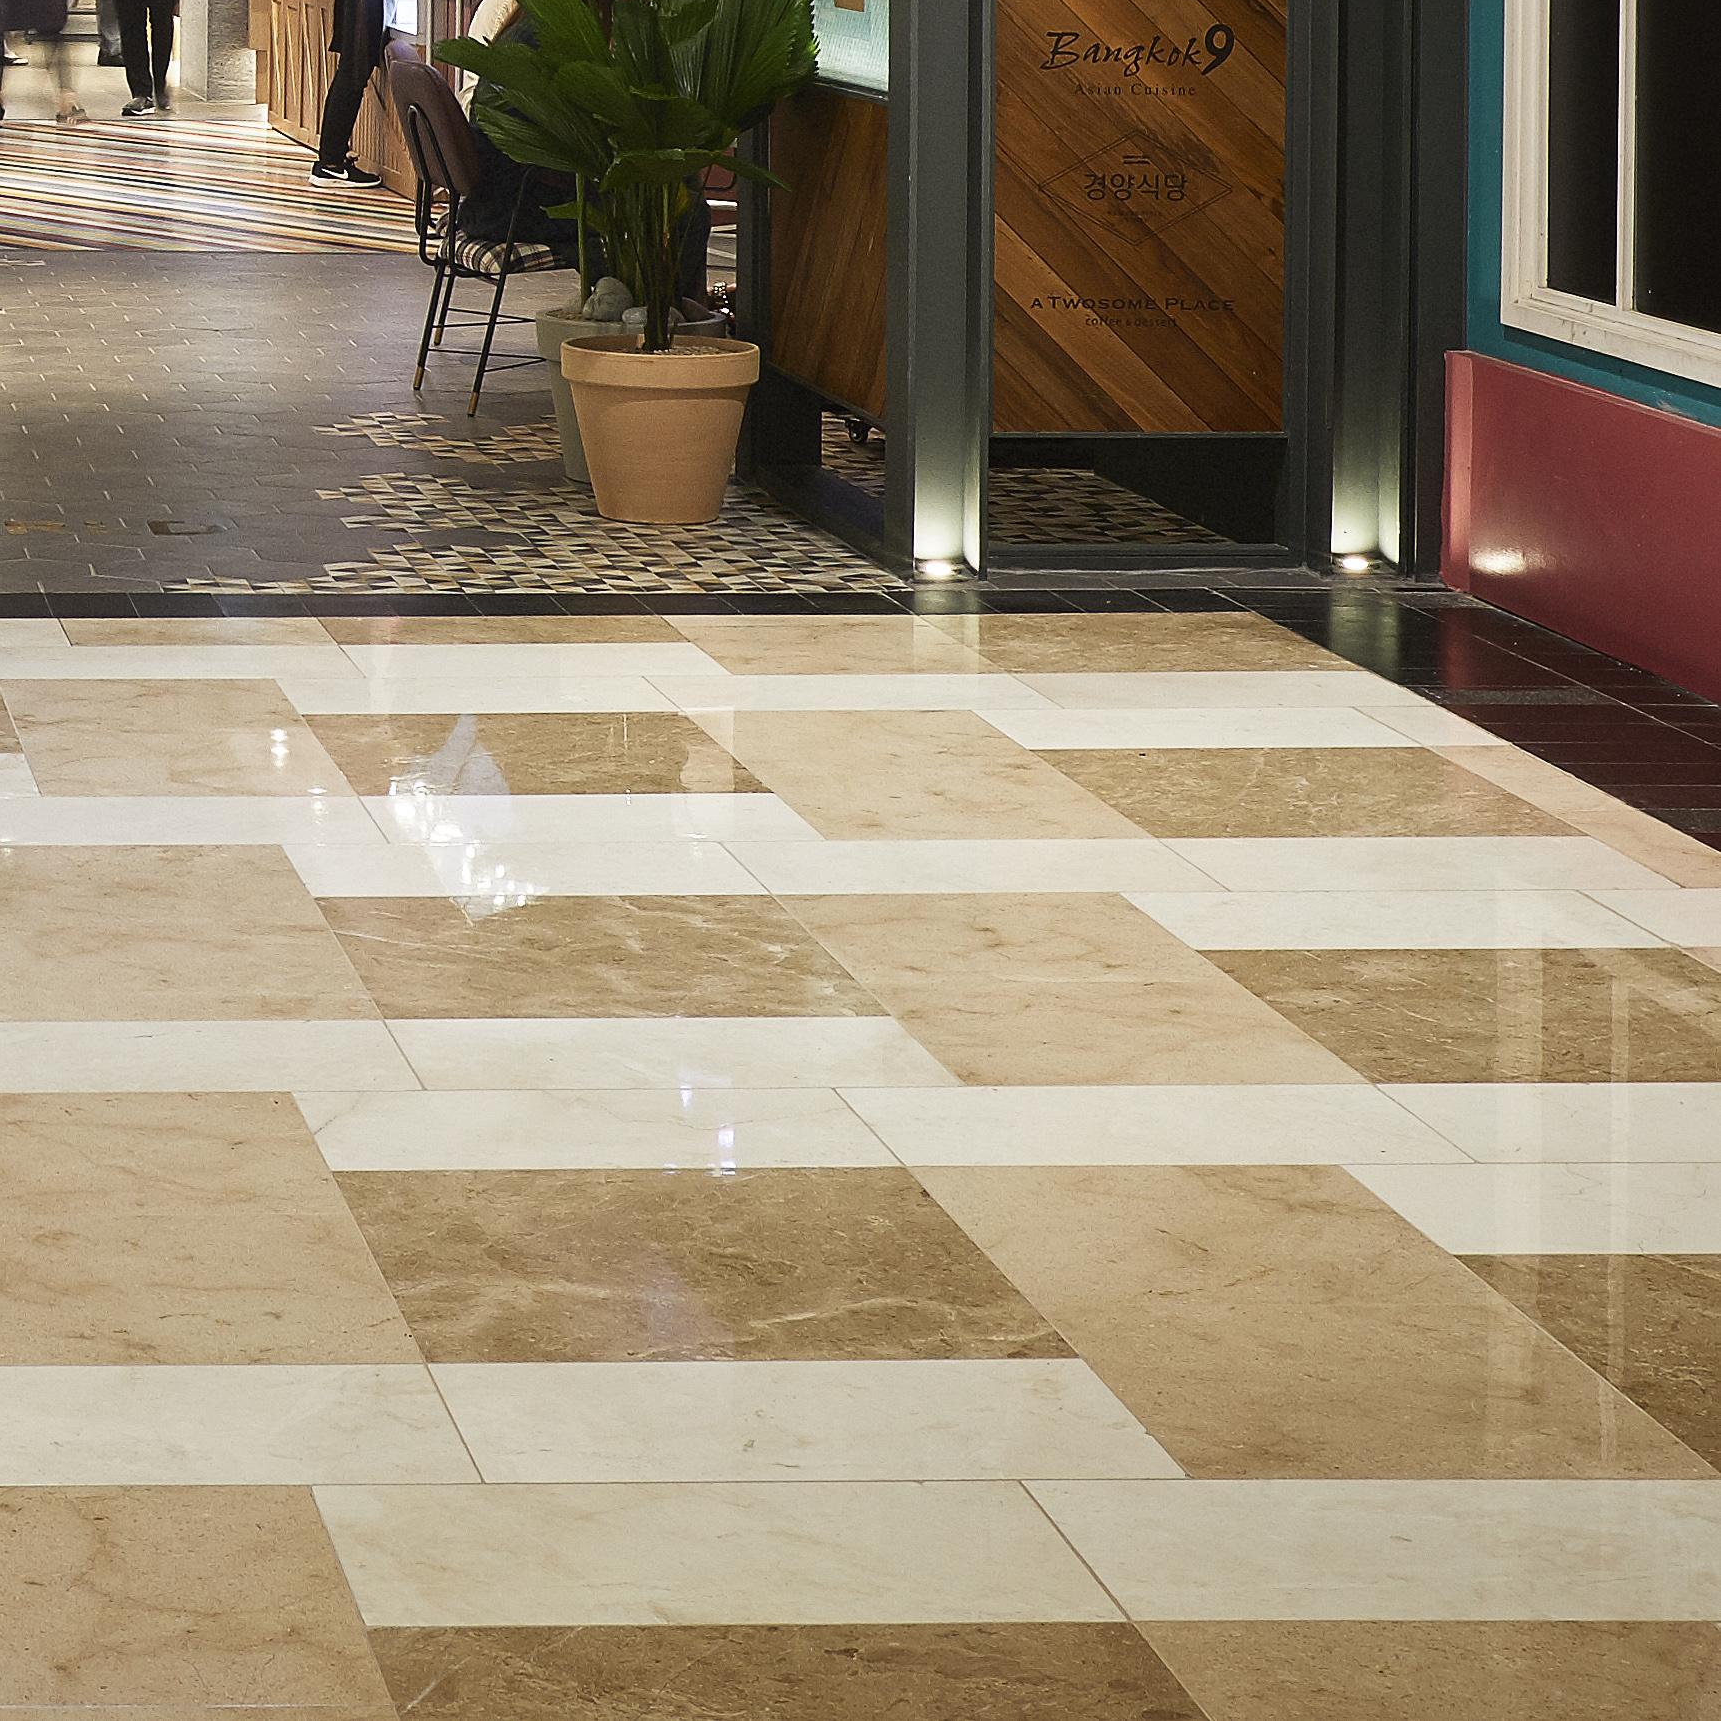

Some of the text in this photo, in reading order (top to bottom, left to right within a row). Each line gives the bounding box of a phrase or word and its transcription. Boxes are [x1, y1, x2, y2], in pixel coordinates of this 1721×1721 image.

[1075, 83, 1196, 96] Asian Cuisine
[1084, 173, 1188, 202] 경양식당
[1030, 296, 1235, 311] A TWOSOME PLACE
[1085, 315, 1122, 328] coffee
[1134, 315, 1178, 328] dessert
